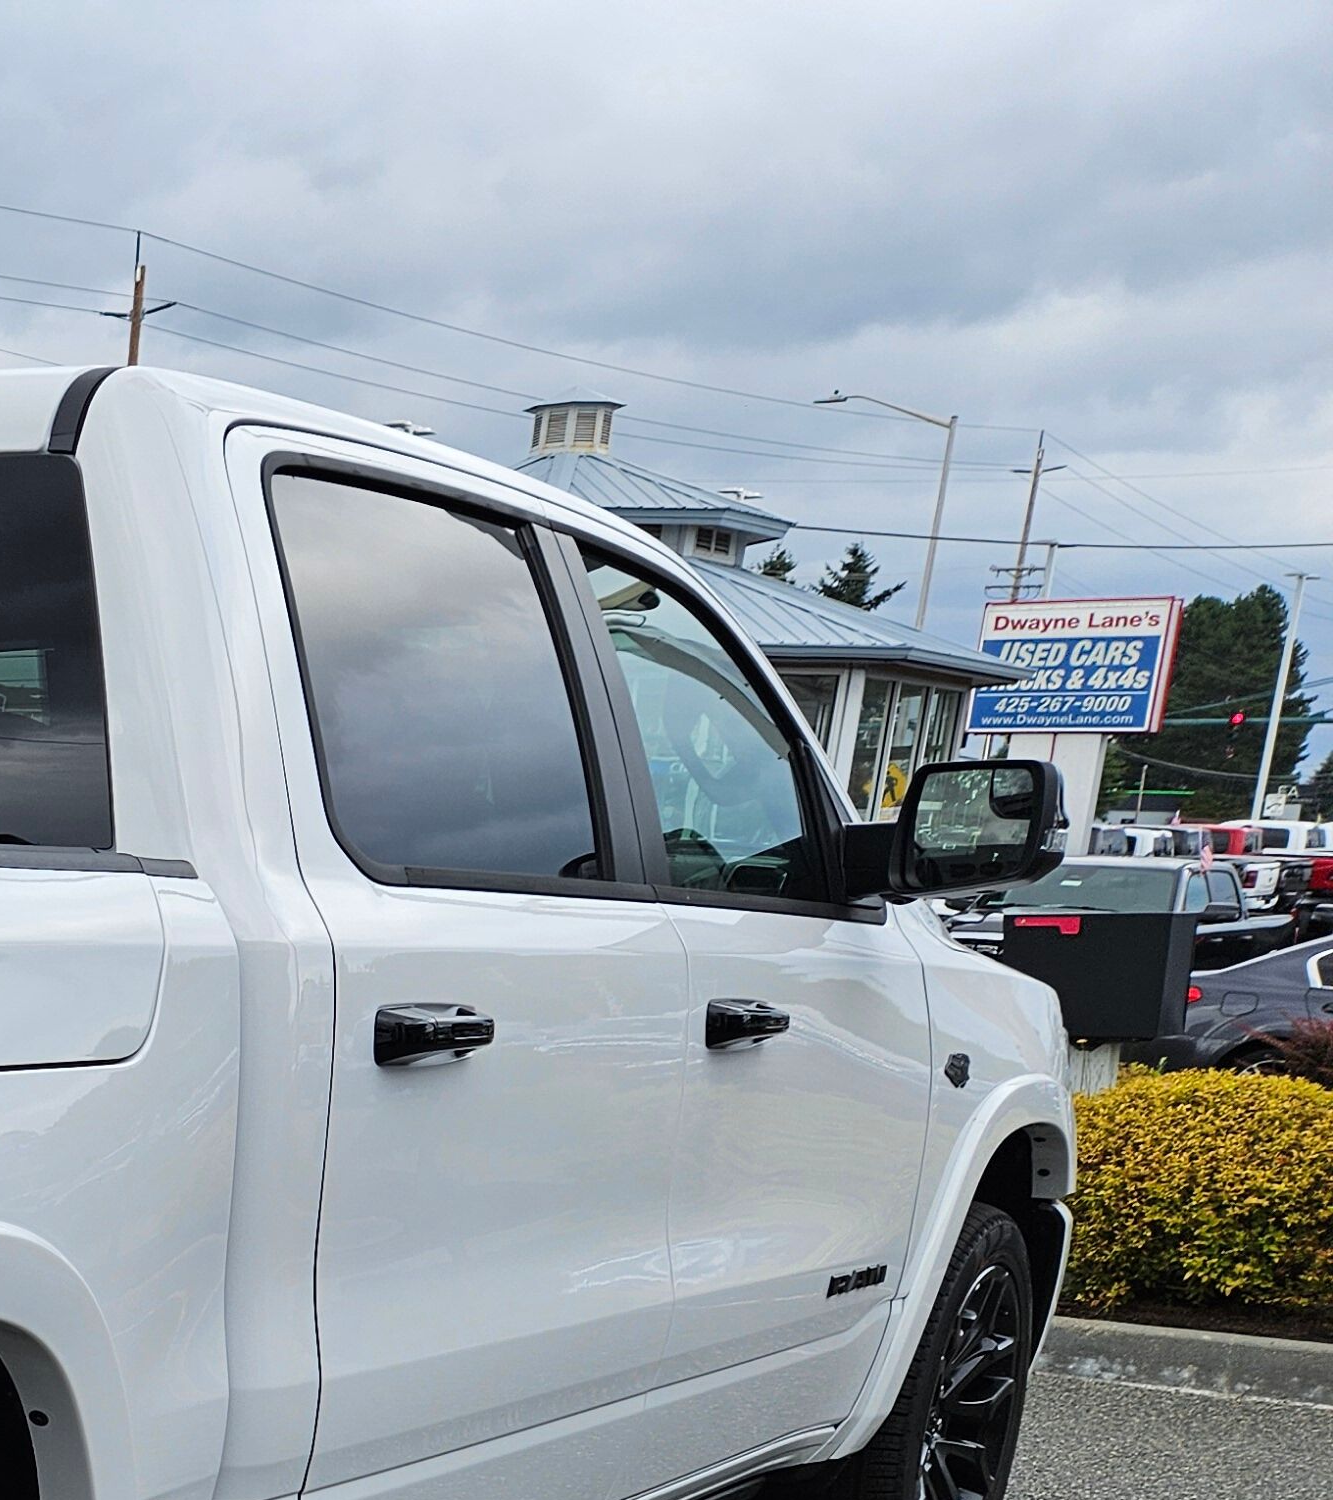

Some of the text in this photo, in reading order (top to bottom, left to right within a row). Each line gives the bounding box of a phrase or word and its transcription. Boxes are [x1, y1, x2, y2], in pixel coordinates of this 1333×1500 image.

[993, 611, 1161, 633] Dwayne Lane's
[998, 639, 1144, 667] USED CARS
[979, 667, 1151, 693] CKS & 4x4s
[994, 695, 1133, 714] 425-267-9000
[981, 713, 1134, 726] www.DwayneLane.com
